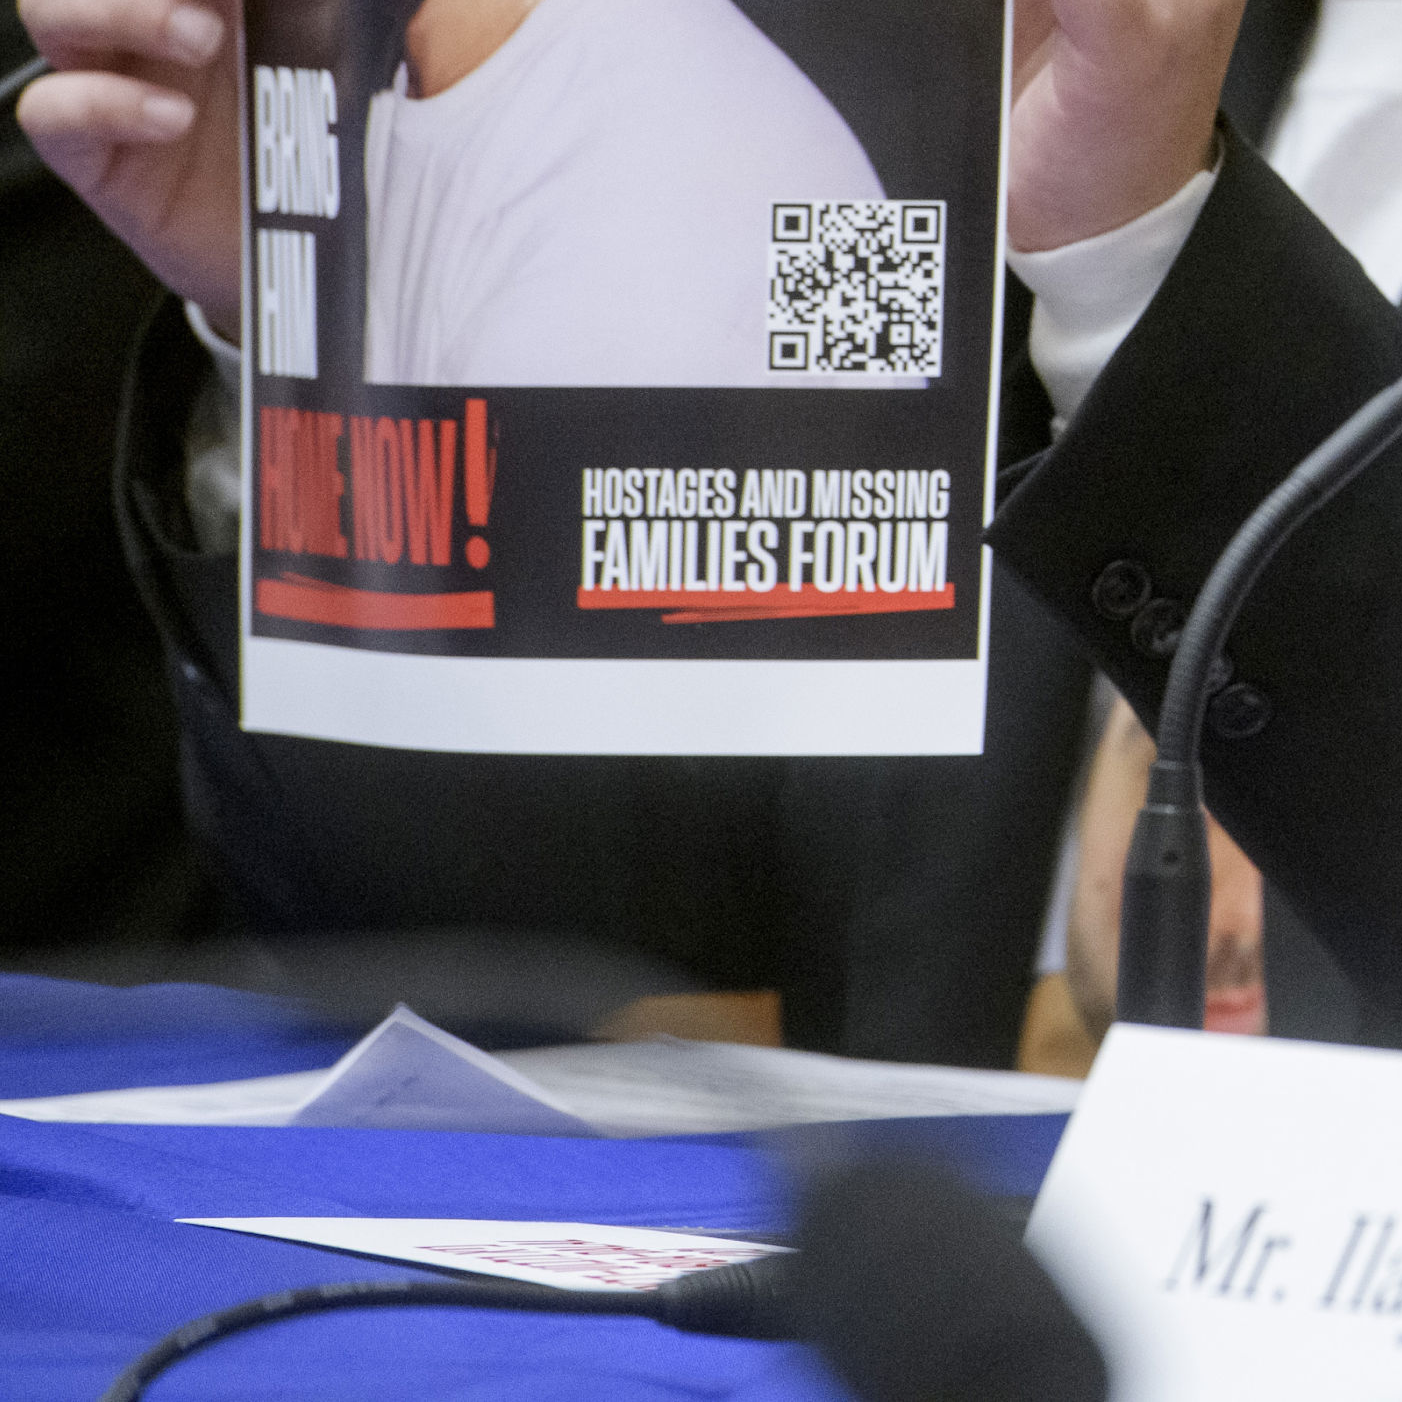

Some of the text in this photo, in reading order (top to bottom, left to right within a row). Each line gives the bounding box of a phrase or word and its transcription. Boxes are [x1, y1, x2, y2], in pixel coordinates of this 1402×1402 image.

[253, 65, 341, 219] BRING
[256, 228, 319, 380] HIM
[582, 467, 951, 520] HOSTAGES AND MISSING
[582, 519, 950, 593] FAMILIES FORUM
[1160, 1196, 1291, 1305] Mr.
